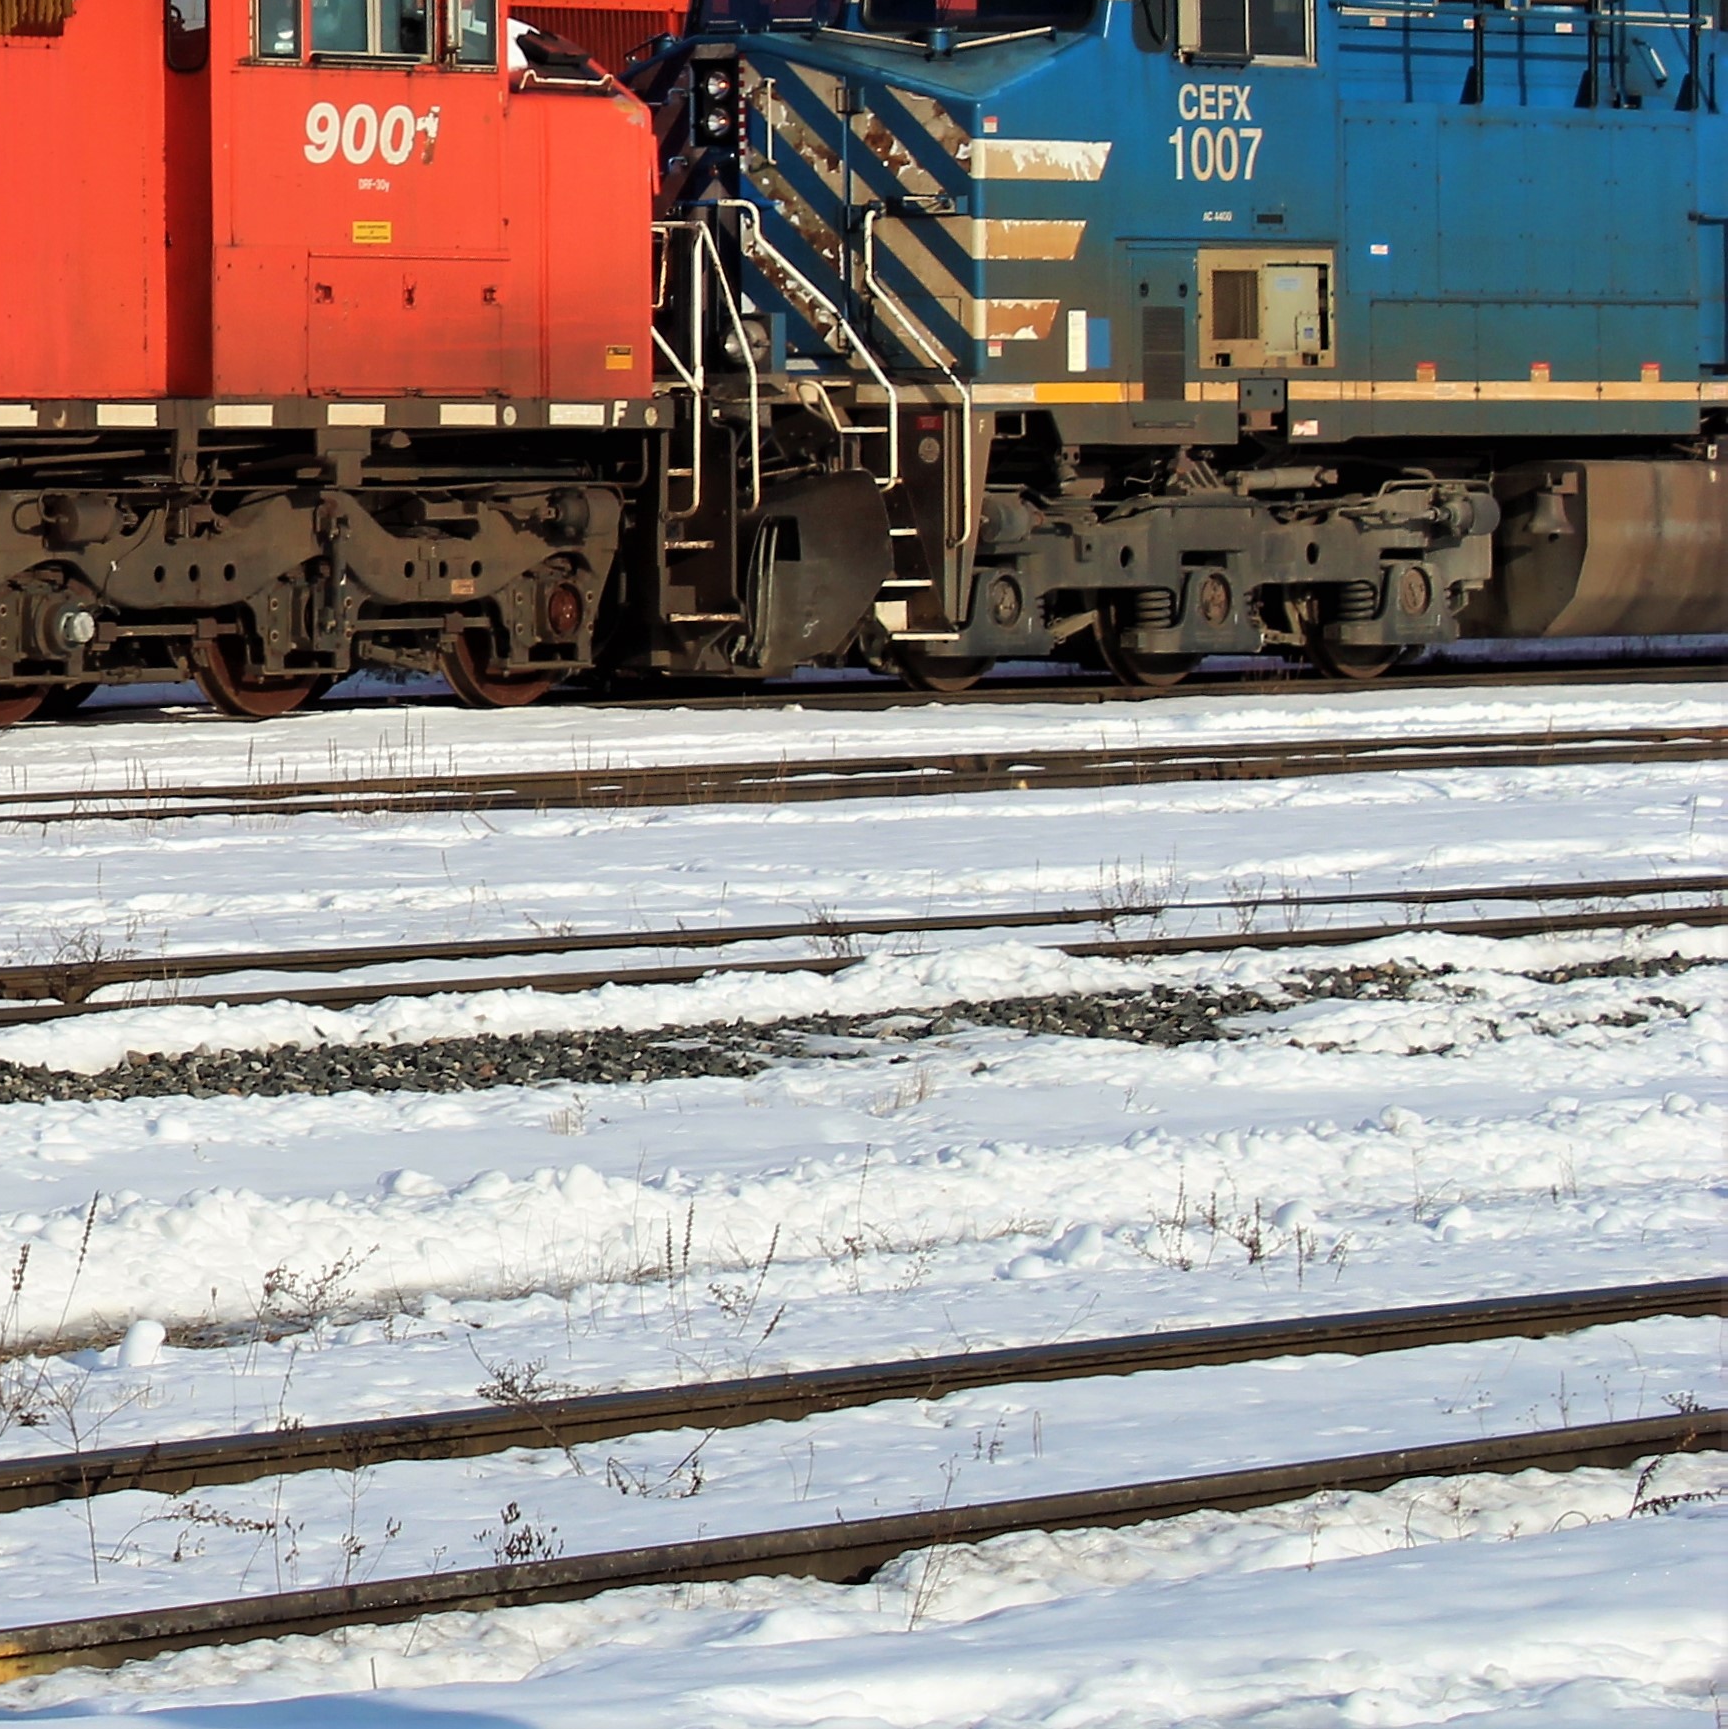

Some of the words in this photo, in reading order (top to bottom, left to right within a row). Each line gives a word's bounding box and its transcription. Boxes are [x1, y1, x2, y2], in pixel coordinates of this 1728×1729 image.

[1177, 82, 1253, 122] CEFX
[1168, 125, 1264, 182] 1007
[612, 399, 629, 427] F
